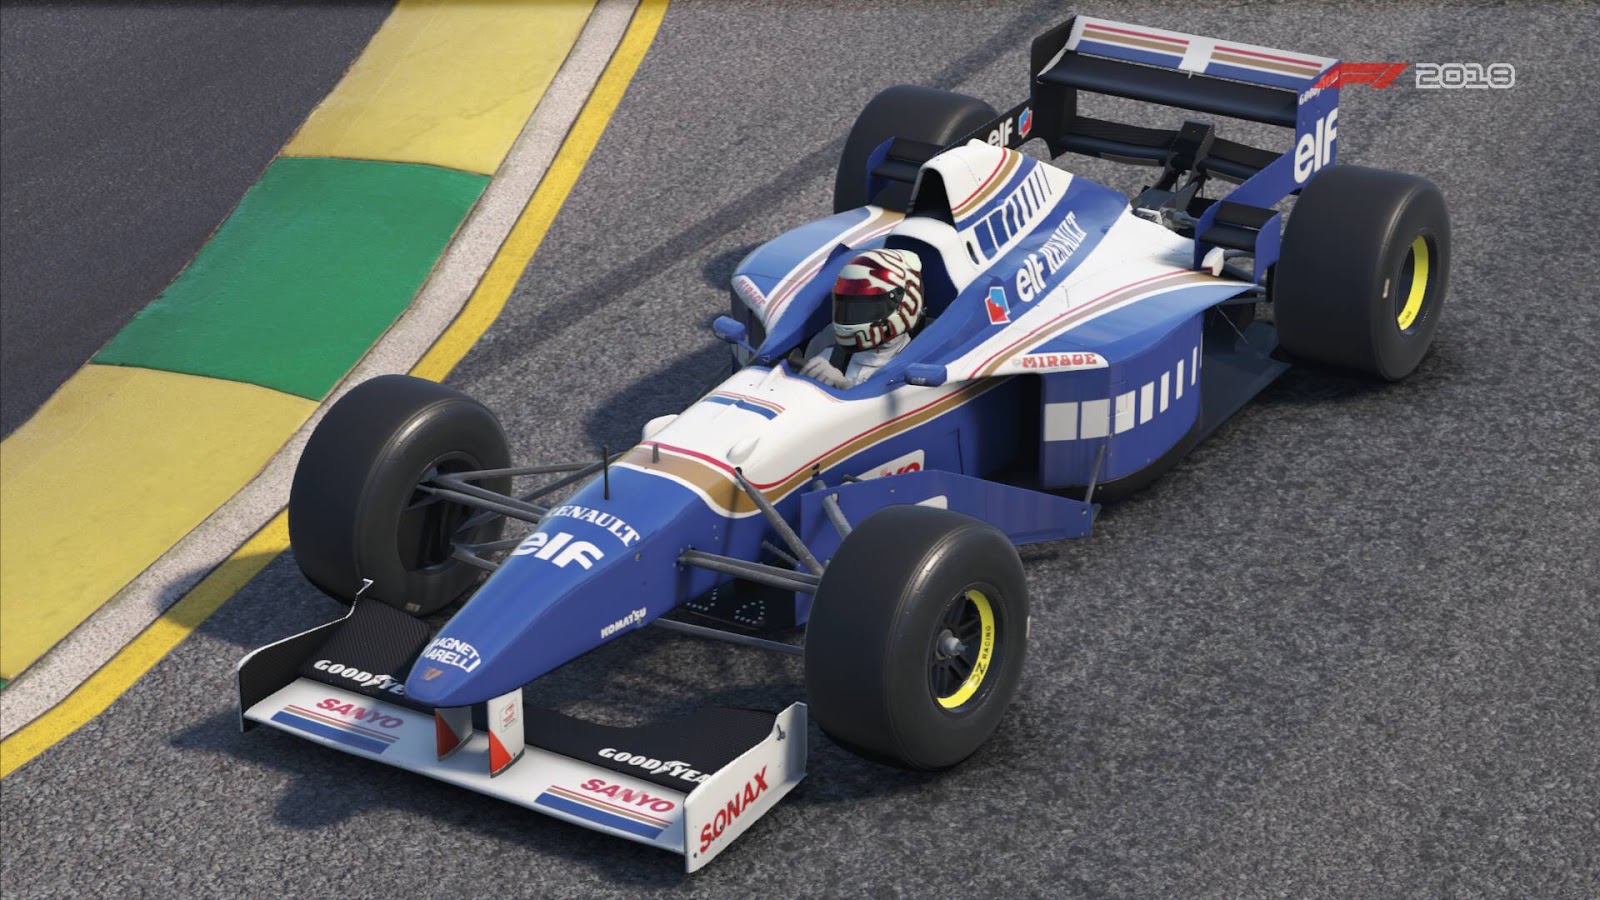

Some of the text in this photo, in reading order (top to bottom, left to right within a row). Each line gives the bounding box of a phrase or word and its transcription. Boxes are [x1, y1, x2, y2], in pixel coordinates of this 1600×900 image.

[987, 116, 1013, 148] elf
[1294, 107, 1338, 183] elf
[1016, 210, 1087, 302] elf RENAULT
[1022, 353, 1097, 369] MIRAGE
[511, 531, 605, 570] elf
[600, 606, 647, 639] KOMATSU
[313, 659, 405, 696] GOODYE
[316, 698, 404, 729] SANYO
[597, 747, 713, 784] GOODYEA
[580, 778, 676, 813] SANYO
[700, 764, 769, 854] SONAX
